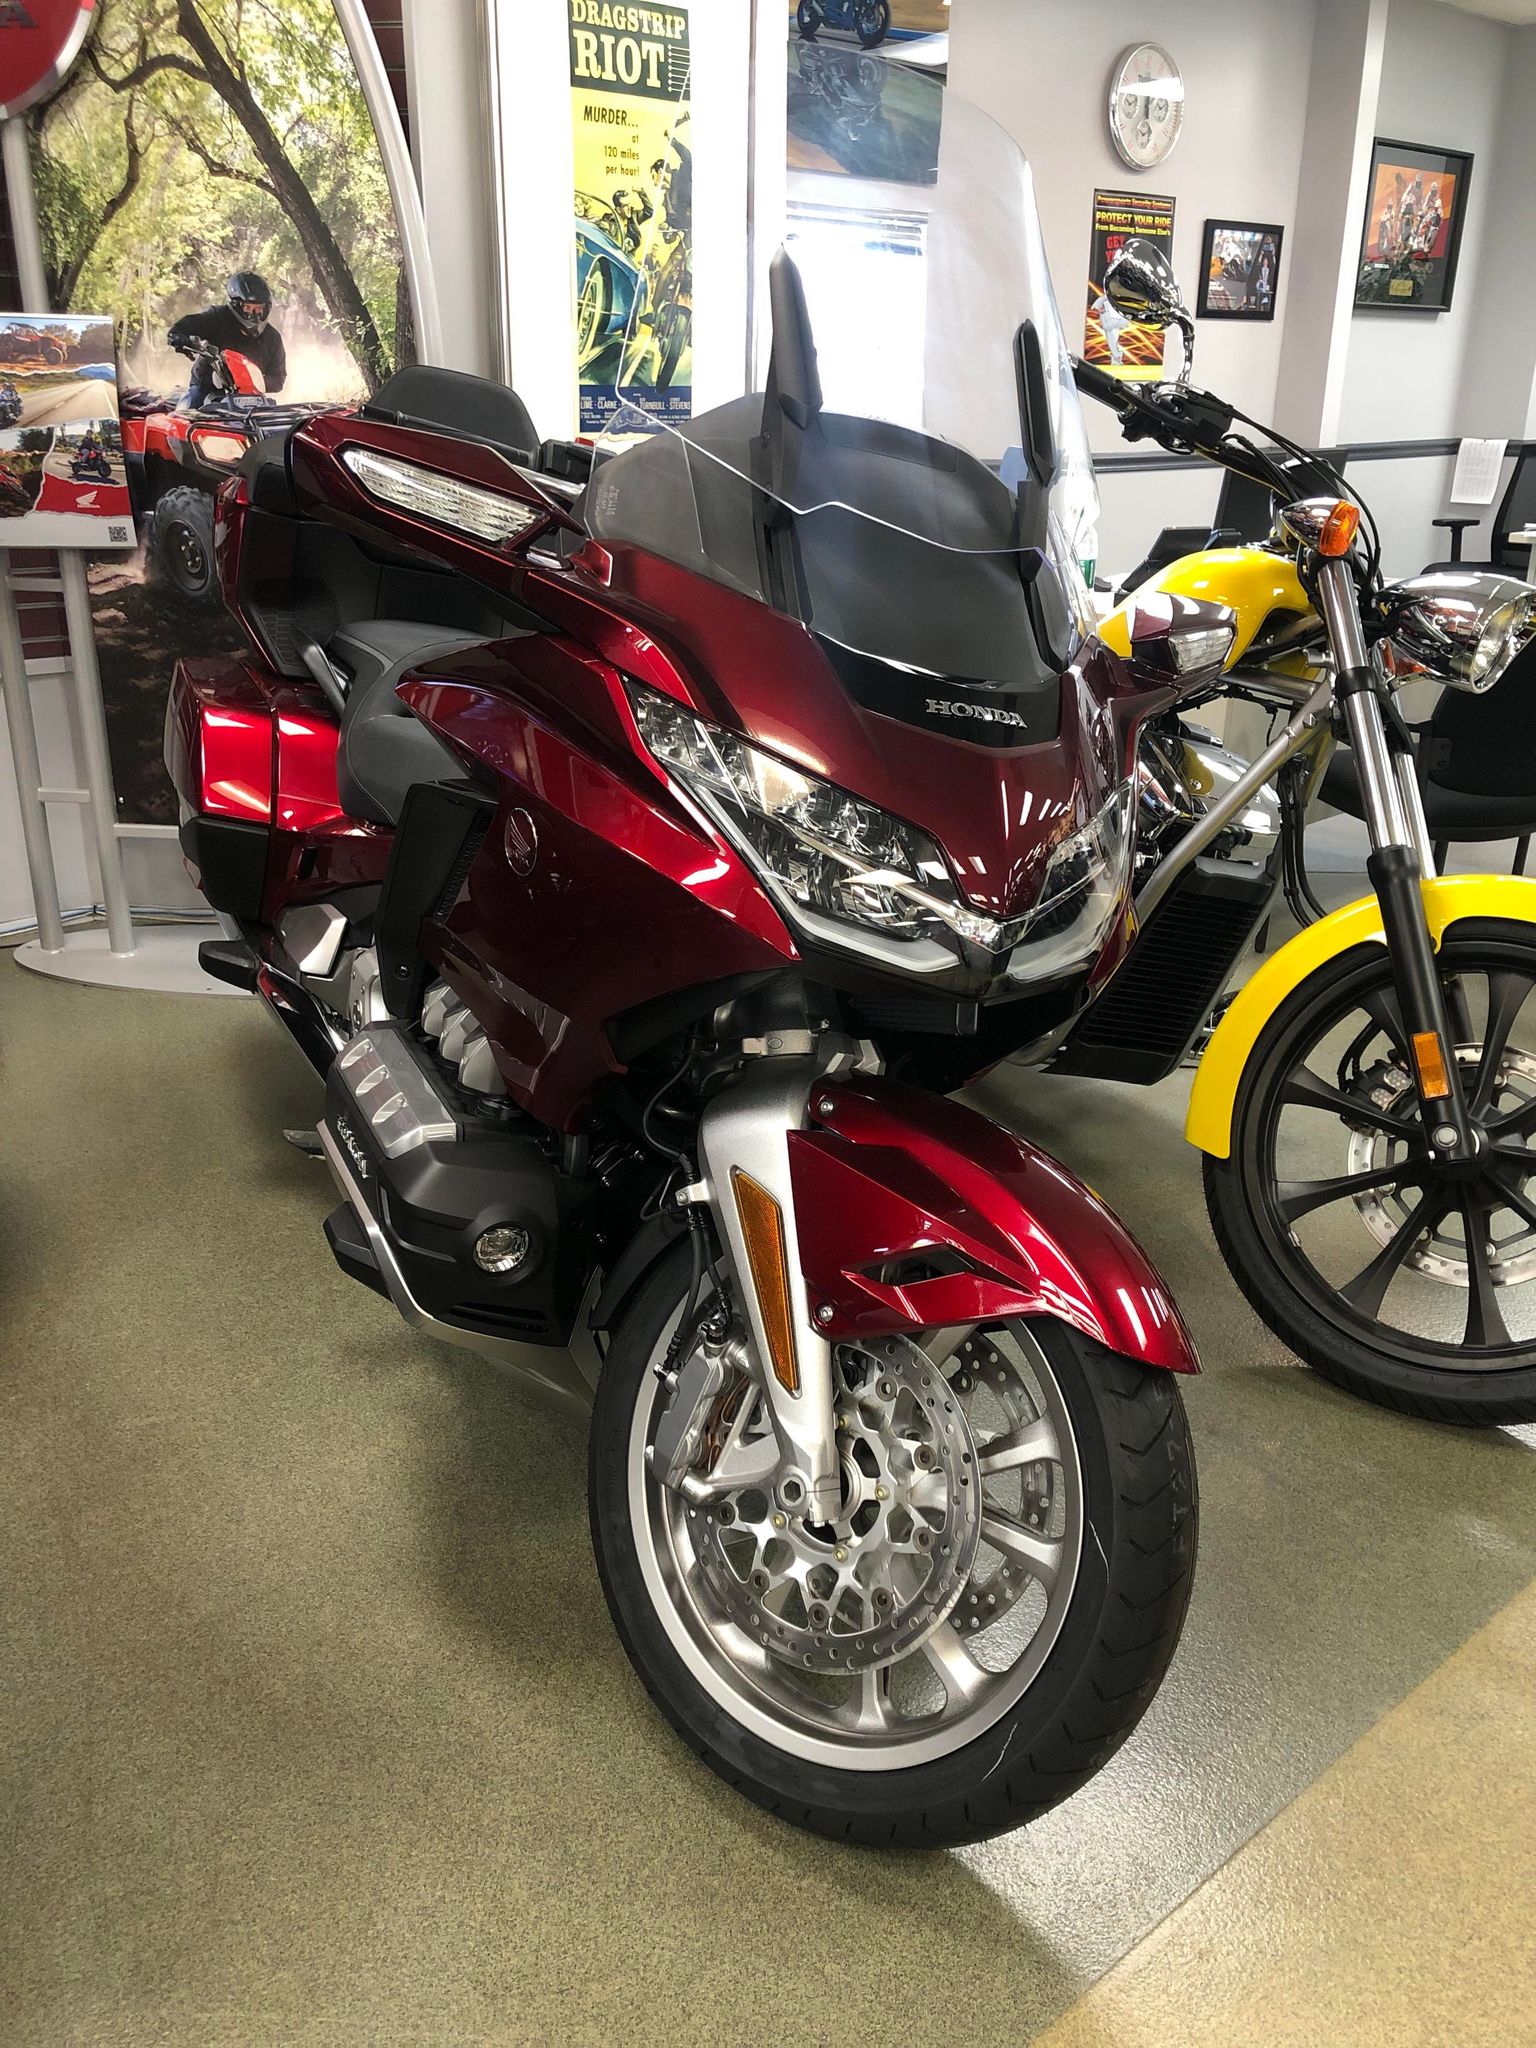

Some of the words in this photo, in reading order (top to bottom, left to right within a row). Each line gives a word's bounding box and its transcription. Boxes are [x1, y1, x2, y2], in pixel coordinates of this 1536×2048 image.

[571, 0, 686, 40] DRAGSTRIP
[573, 28, 665, 88] RIOT
[583, 105, 639, 127] MURDER...
[631, 134, 639, 143] at
[604, 145, 618, 158] 120
[620, 148, 640, 160] miles
[605, 165, 617, 176] per
[620, 163, 640, 176] hour!
[1096, 211, 1133, 224] PROTECT
[1133, 214, 1153, 226] YOUR
[1154, 216, 1172, 228] RIDE
[1095, 223, 1109, 231] From
[1109, 224, 1135, 234] Becoming
[1135, 226, 1157, 235] Someone
[669, 401, 691, 410] STEVENS
[925, 698, 1028, 729] HONDA
